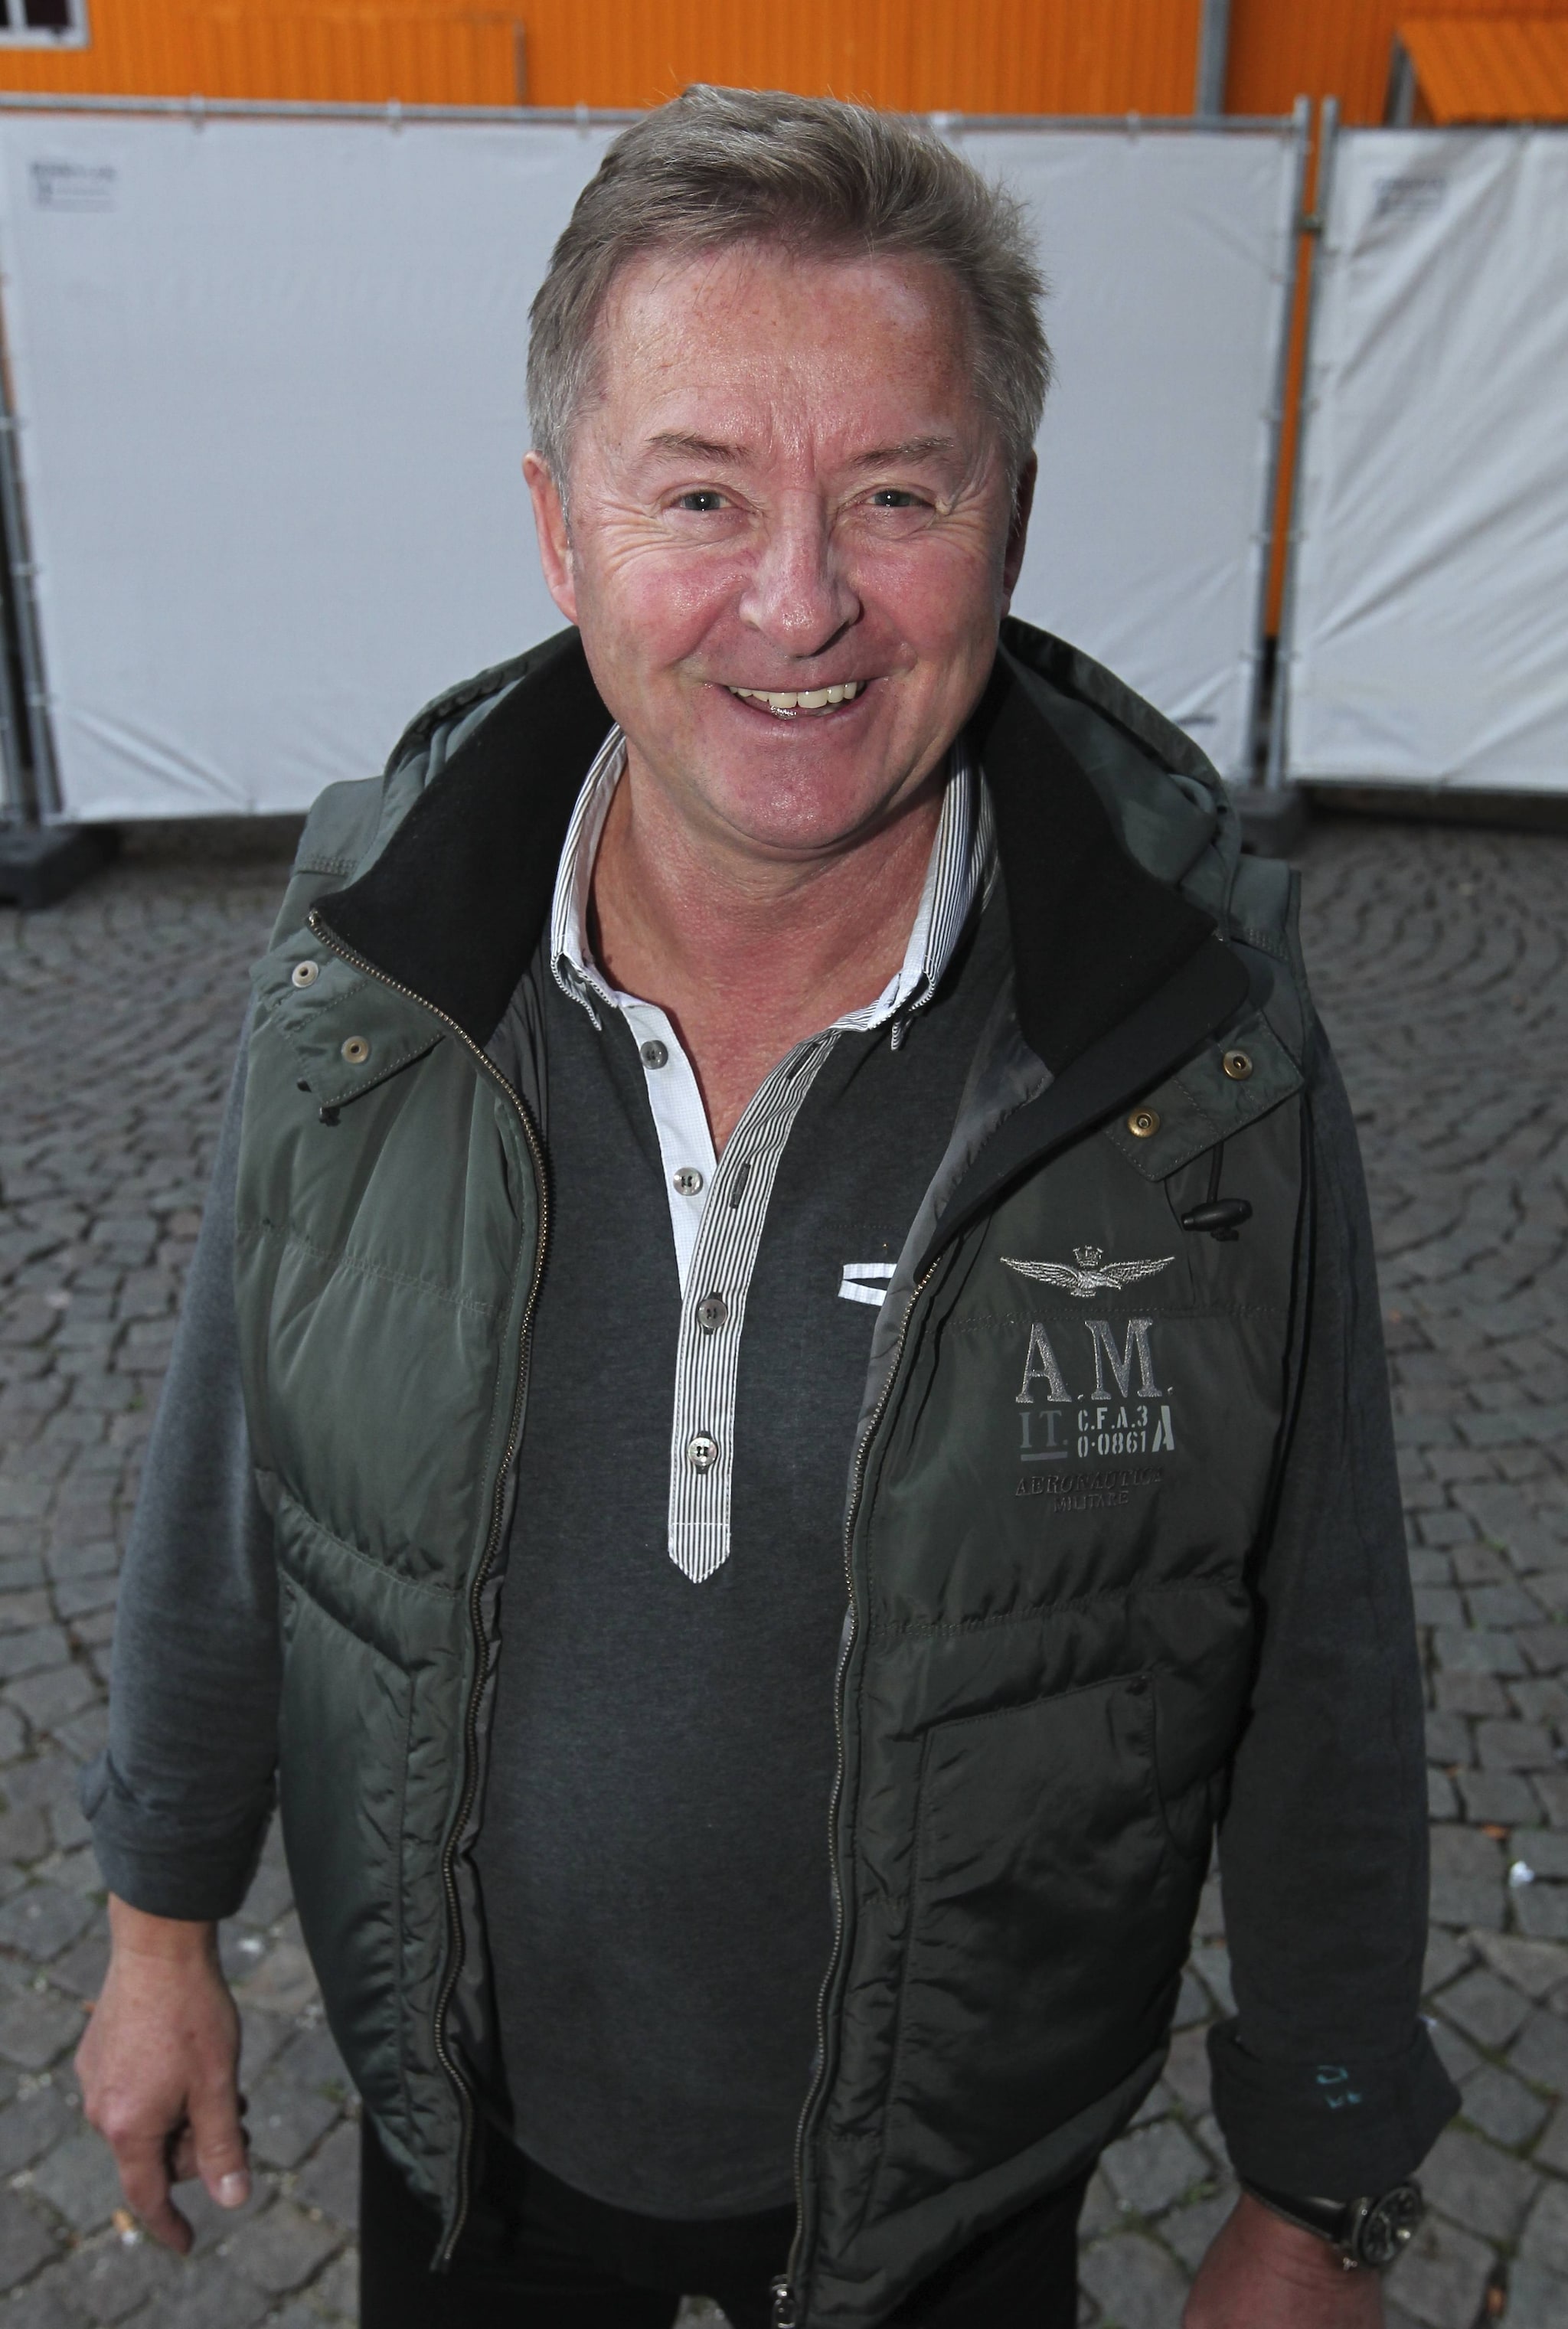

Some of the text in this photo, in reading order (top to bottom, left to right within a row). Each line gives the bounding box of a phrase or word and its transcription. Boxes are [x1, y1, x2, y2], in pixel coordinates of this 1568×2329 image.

[1019, 1409, 1069, 1449] IT.
[1078, 1405, 1148, 1432] C.F.A.3
[1152, 1405, 1174, 1452] A
[1015, 1465, 1165, 1497] AERONAUTICA
[1054, 1490, 1129, 1513] MILITARE
